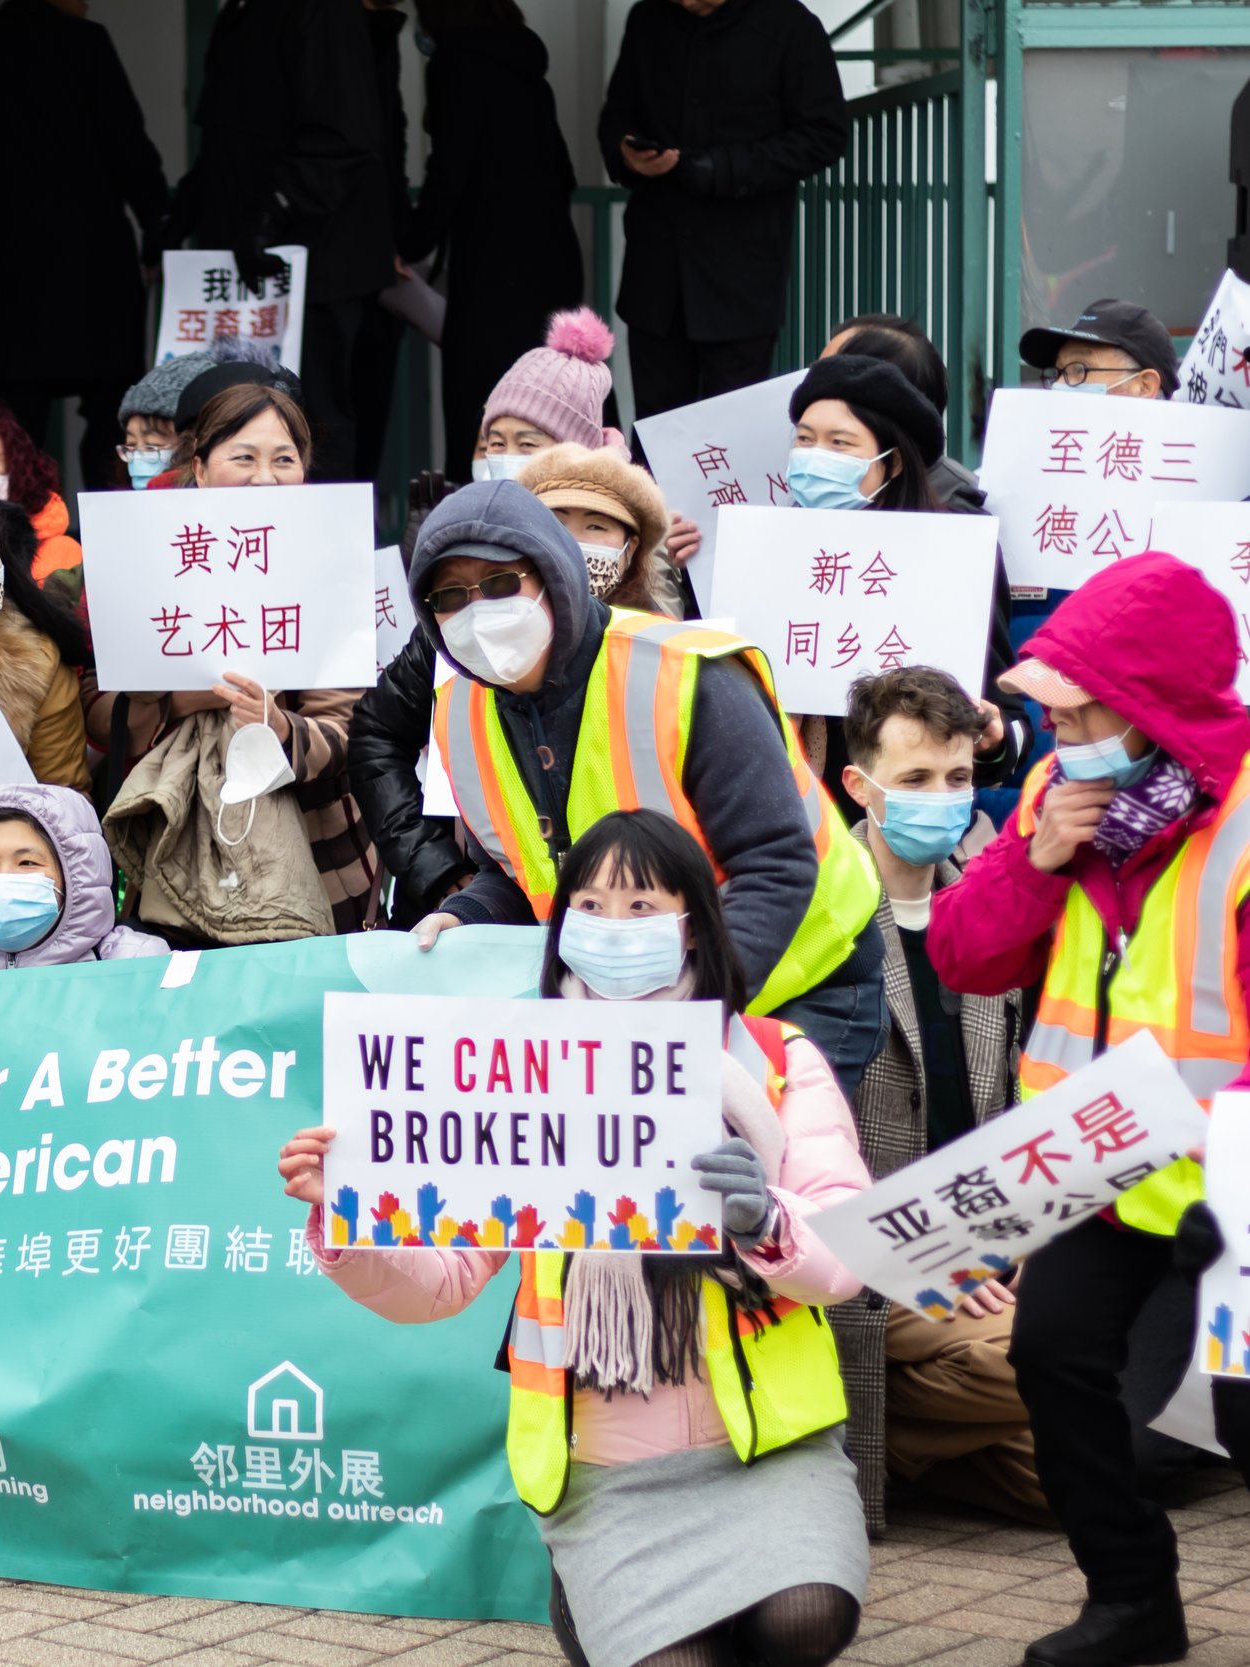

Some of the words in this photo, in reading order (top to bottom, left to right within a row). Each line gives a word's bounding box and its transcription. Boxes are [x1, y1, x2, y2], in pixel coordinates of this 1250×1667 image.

[175, 302, 290, 342] 亞裔選
[1040, 428, 1199, 484] 至德三
[169, 522, 276, 578] 黄河
[1032, 503, 1154, 560] 德公
[808, 547, 899, 598] 新会
[149, 602, 302, 657] 艺术团
[785, 619, 913, 670] 同乡会
[19, 1051, 65, 1112] A
[86, 1035, 297, 1104] Better
[358, 1033, 425, 1092] WE
[453, 1036, 603, 1096] CAN'T
[630, 1040, 687, 1096] BE
[370, 1108, 567, 1167] BROKEN
[597, 1113, 676, 1169] UP.
[867, 1090, 1150, 1252] 亚裔不是
[189, 1440, 386, 1499] 邻里外展
[133, 1489, 319, 1517] neighborhood
[327, 1499, 444, 1526] outreach
